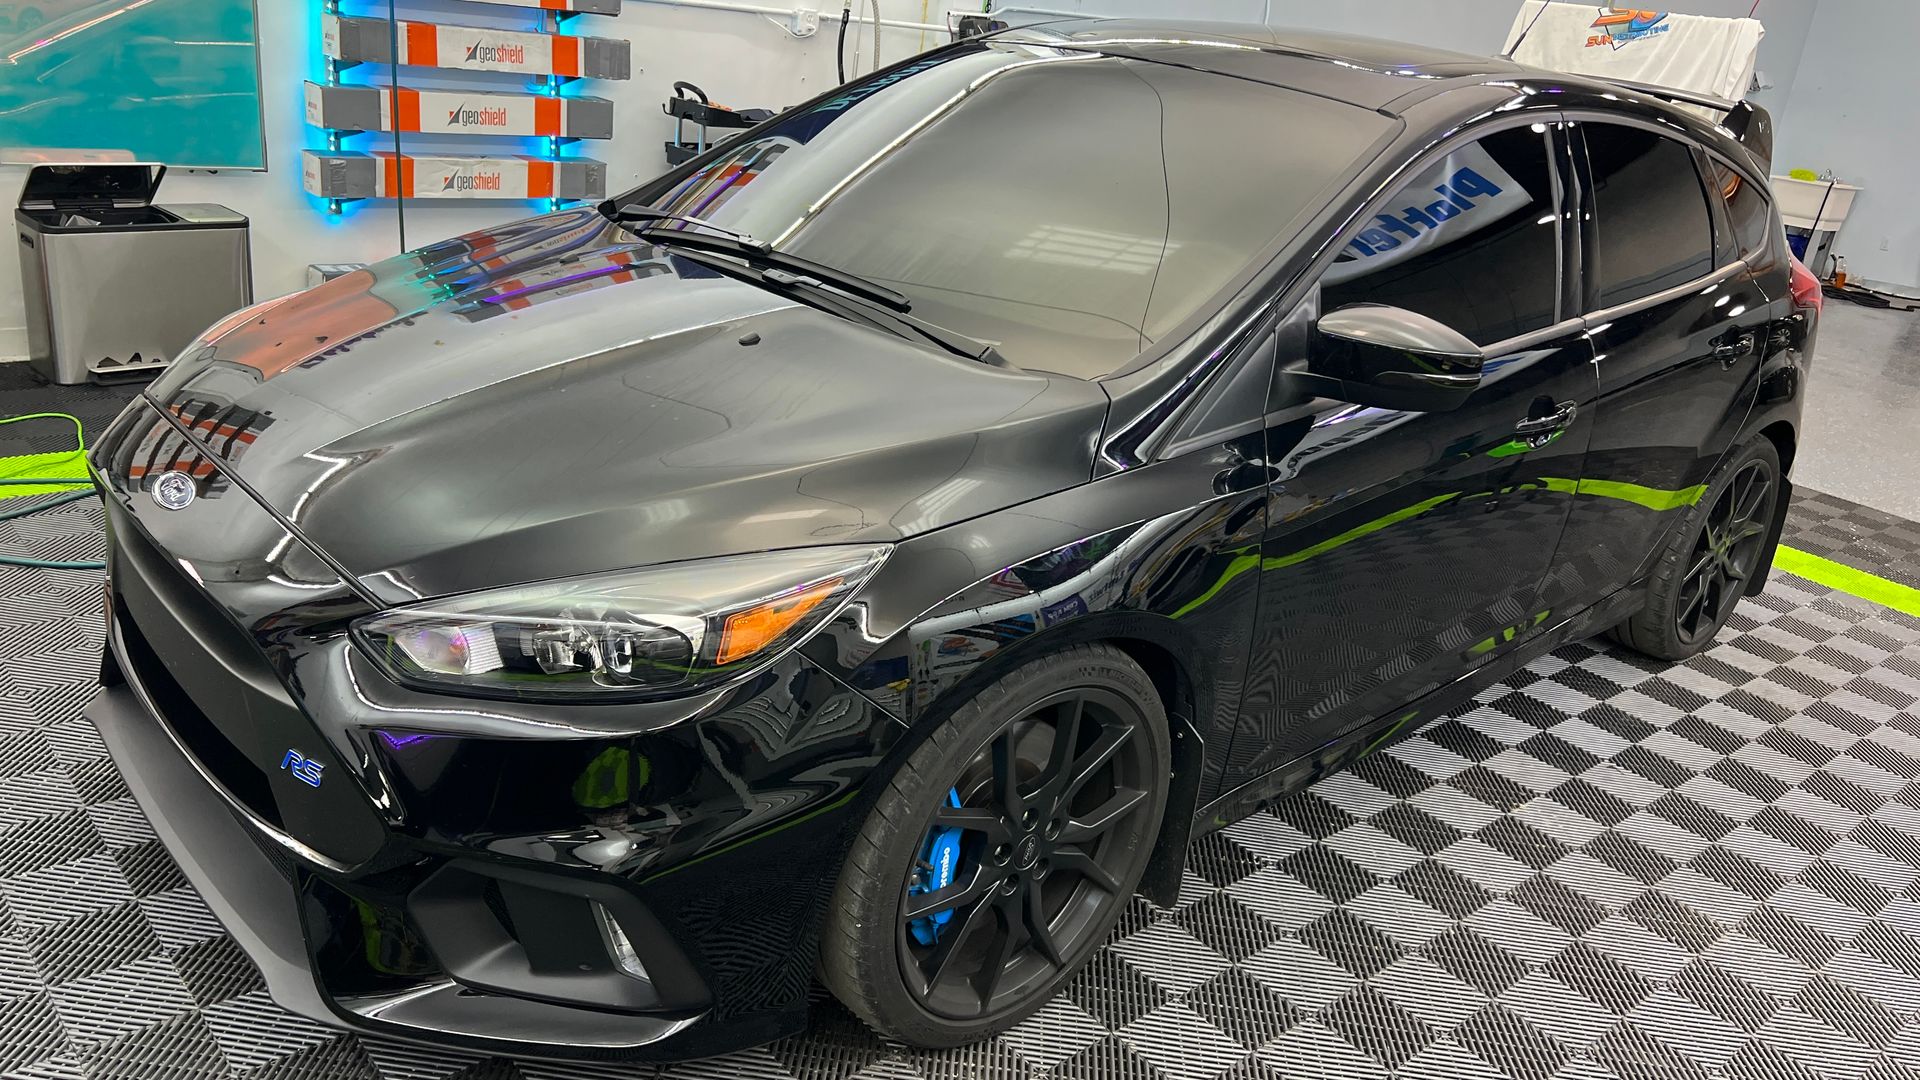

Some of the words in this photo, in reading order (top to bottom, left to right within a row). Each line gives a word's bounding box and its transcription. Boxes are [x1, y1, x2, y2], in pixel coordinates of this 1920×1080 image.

[479, 43, 523, 64] geoshield
[462, 106, 506, 126] geoshield
[456, 172, 500, 192] geoshield
[161, 479, 186, 502] Ford
[280, 748, 324, 788] RS
